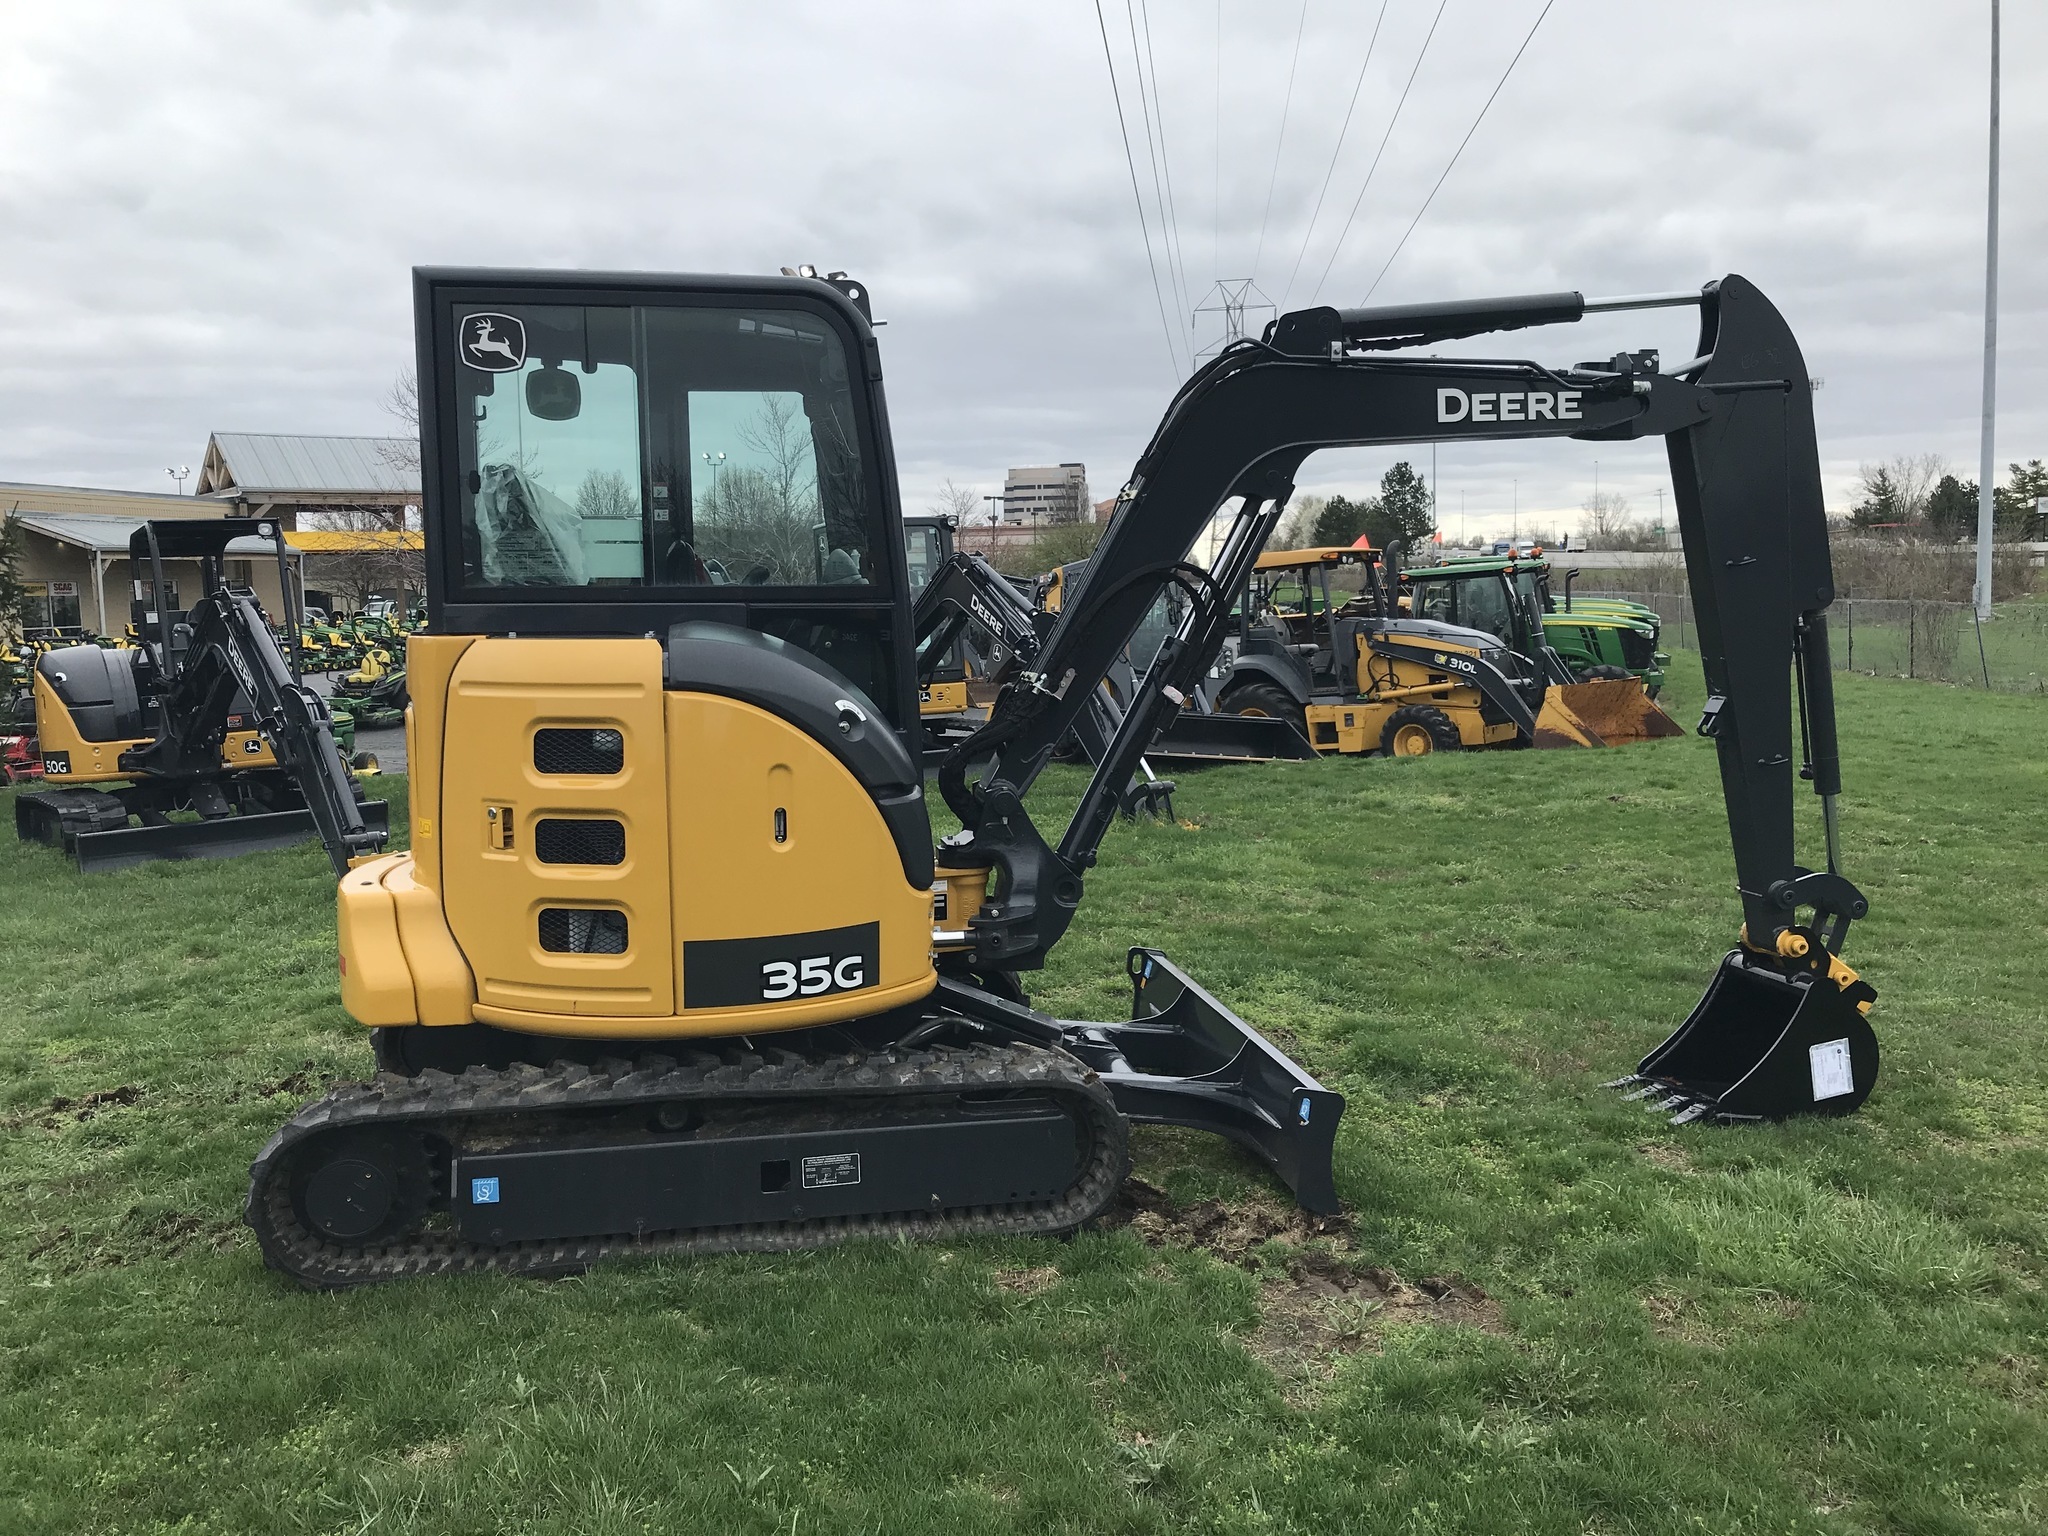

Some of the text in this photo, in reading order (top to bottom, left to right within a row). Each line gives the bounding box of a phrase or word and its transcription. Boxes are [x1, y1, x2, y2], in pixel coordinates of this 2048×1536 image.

[1436, 387, 1583, 423] DEERE
[970, 593, 1004, 637] DEERE
[227, 636, 254, 695] DEERE
[1449, 657, 1478, 675] 310L
[45, 760, 67, 774] 50G
[762, 955, 863, 999] 35G
